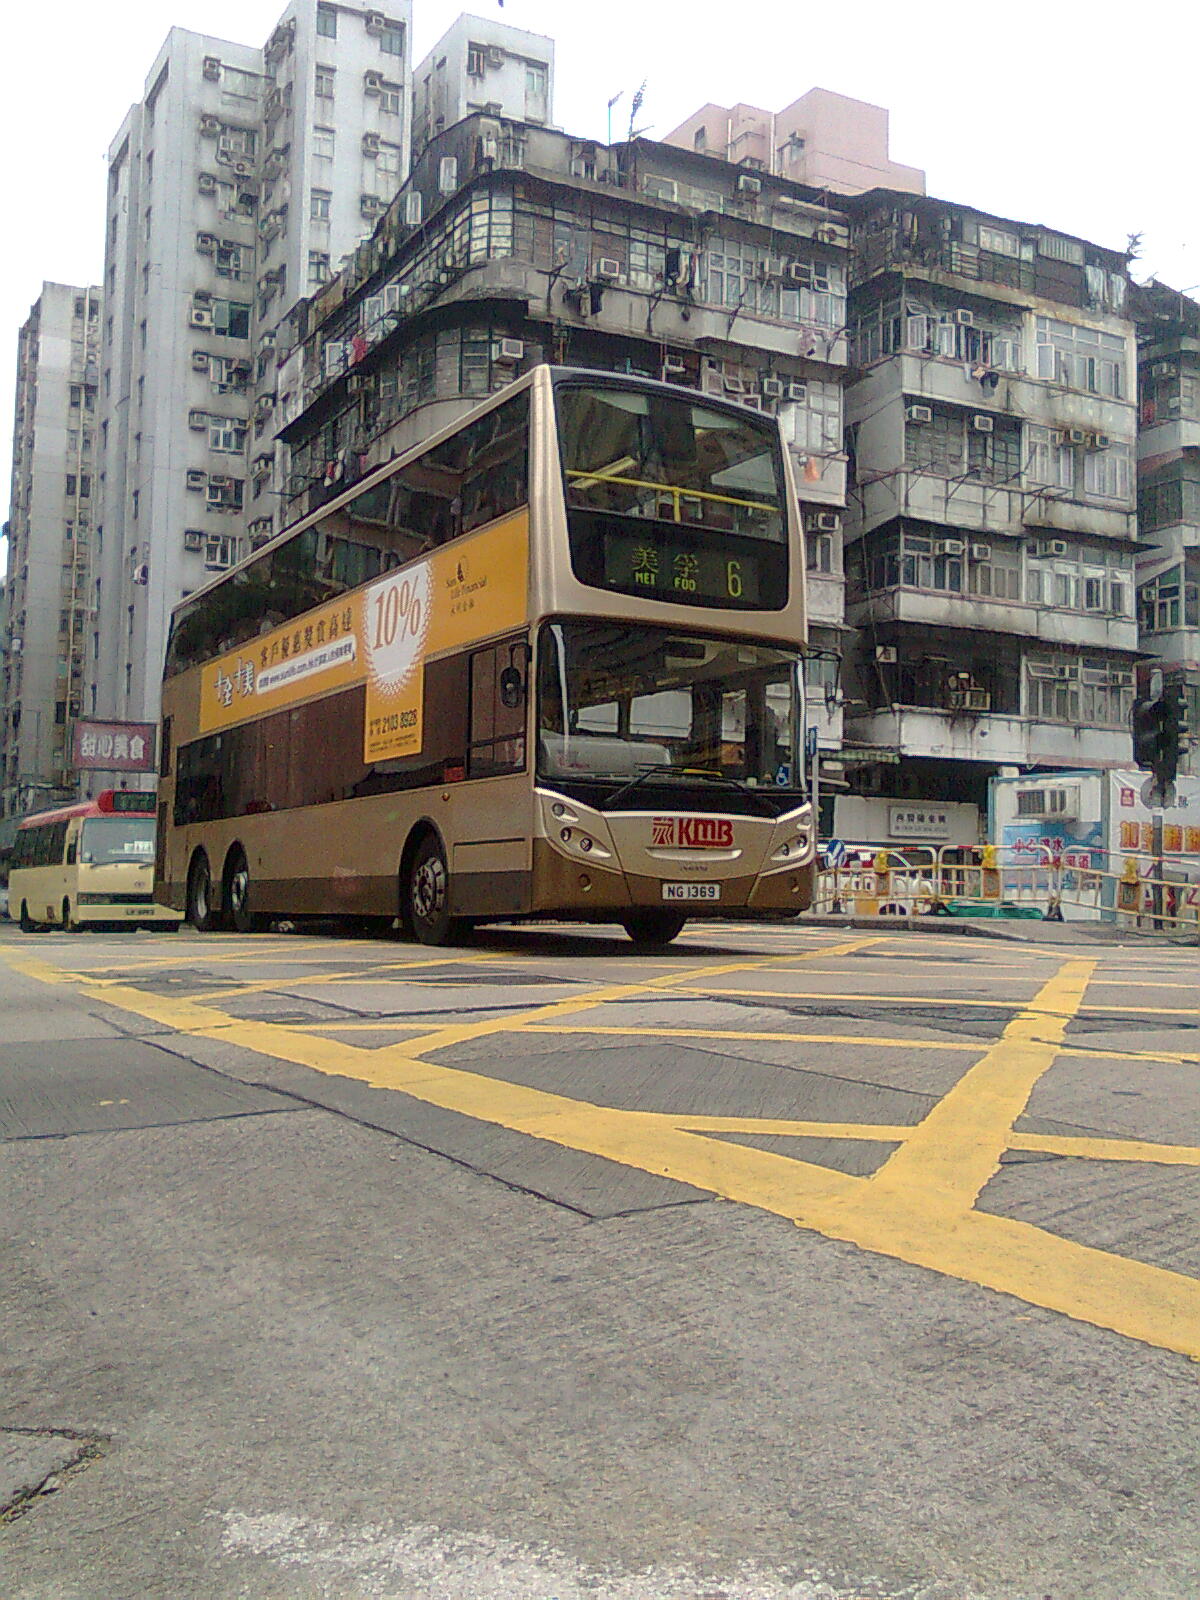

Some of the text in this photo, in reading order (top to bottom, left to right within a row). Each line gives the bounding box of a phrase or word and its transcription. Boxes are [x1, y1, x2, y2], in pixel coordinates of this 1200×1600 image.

[631, 545, 700, 578] 美孚
[635, 572, 696, 592] MEI FOO
[727, 560, 743, 598] 6
[374, 575, 422, 651] 10%
[678, 817, 734, 847] KMB
[667, 886, 684, 898] NG
